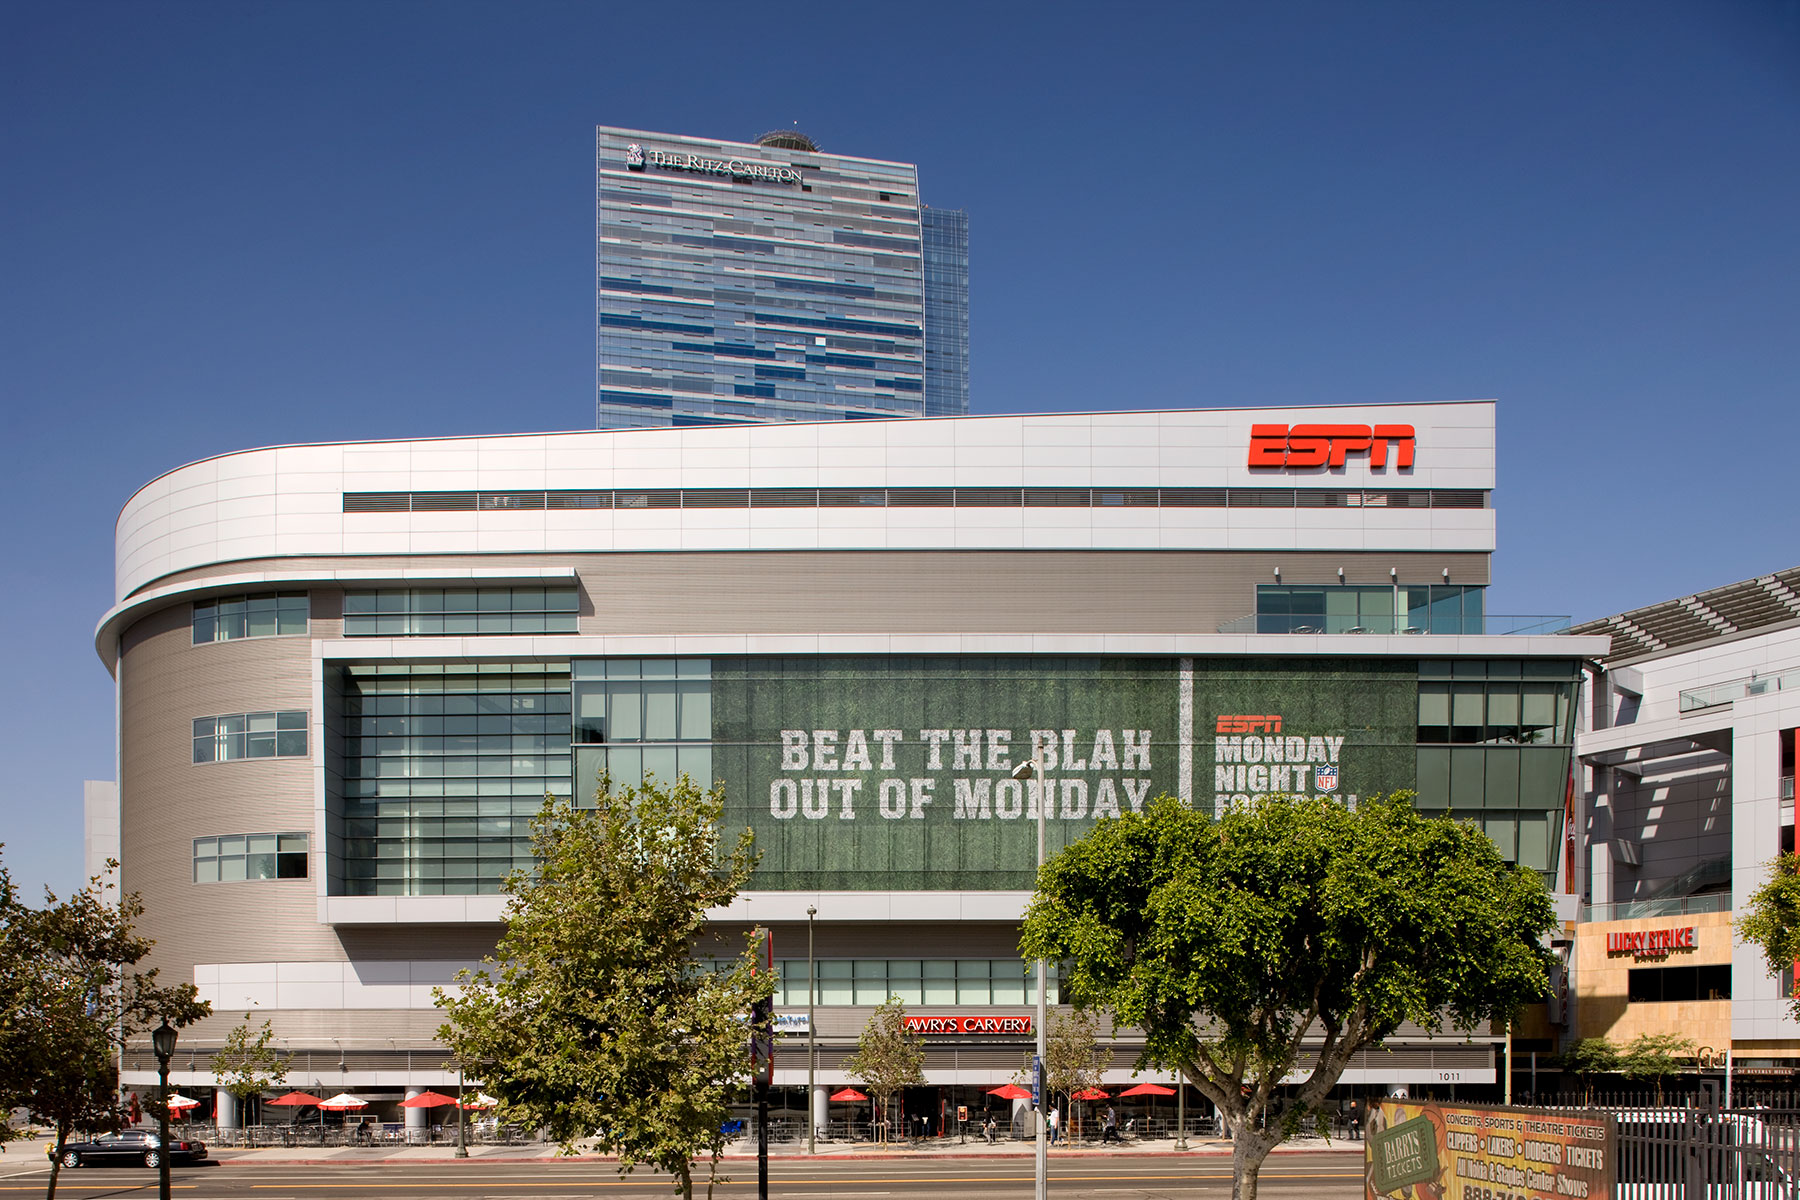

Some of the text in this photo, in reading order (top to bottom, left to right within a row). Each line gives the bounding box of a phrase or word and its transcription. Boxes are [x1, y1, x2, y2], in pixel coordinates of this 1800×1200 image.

[649, 150, 802, 181] THE RITZ-CARLTON
[1248, 424, 1415, 467] ESPN
[1215, 715, 1282, 733] ESPN
[780, 729, 1152, 771] BEAT THE BLAH
[1215, 736, 1345, 763] MONDAY
[1215, 765, 1311, 792] NIGHT
[1317, 776, 1336, 789] NFL
[770, 778, 1152, 820] OUT OF MONDAY
[1607, 927, 1693, 951] LUCKY STRIKE
[1634, 949, 1668, 957] LANES
[902, 1018, 1029, 1031] AWRY'S CARVERY
[1439, 1072, 1460, 1081] 1011
[1446, 1114, 1605, 1141] CONCERTS, SPORTS & THEATRE TICKETS
[1446, 1131, 1604, 1170] CLIPPERS LAKERS DODGERS TICKETS
[1386, 1156, 1423, 1179] TICKETS
[1457, 1157, 1466, 1177] All
[1467, 1158, 1488, 1181] Nokia
[1489, 1161, 1496, 1183] &
[1496, 1163, 1525, 1189] Staples
[1526, 1167, 1555, 1192] Center
[1557, 1172, 1588, 1198] Shows
